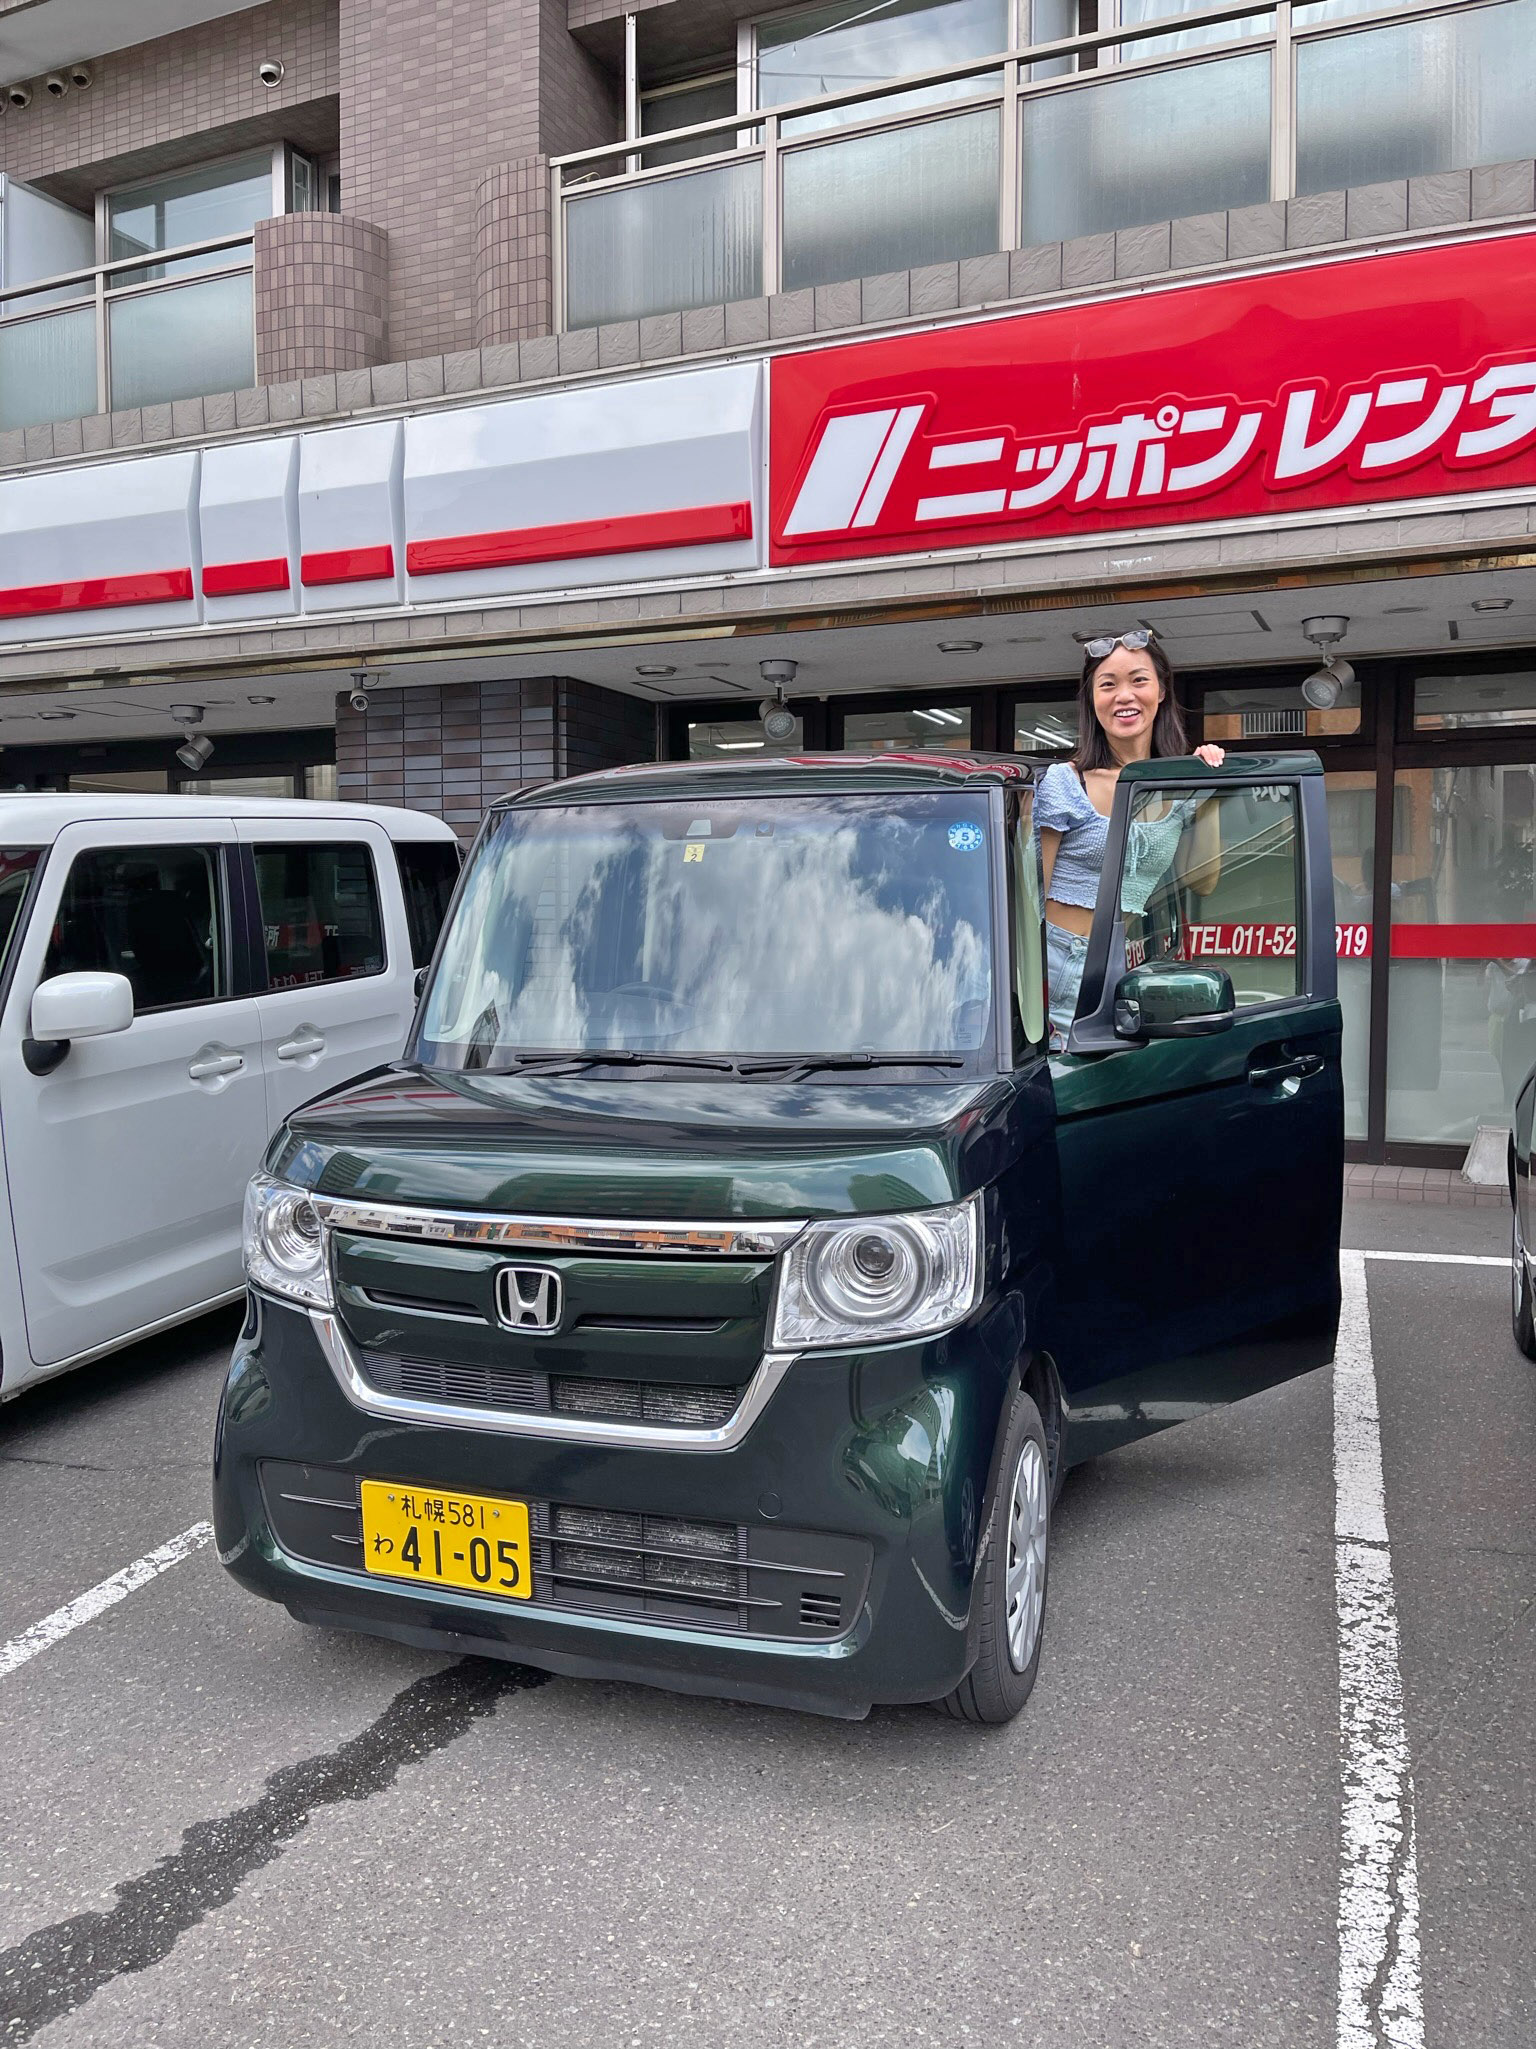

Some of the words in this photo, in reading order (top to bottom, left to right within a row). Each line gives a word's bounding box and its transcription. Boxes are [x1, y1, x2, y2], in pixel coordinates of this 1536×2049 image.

[962, 832, 970, 841] 5
[401, 1495, 485, 1529] 札幌581
[373, 1532, 394, 1555] わ
[401, 1526, 520, 1588] 41-05
